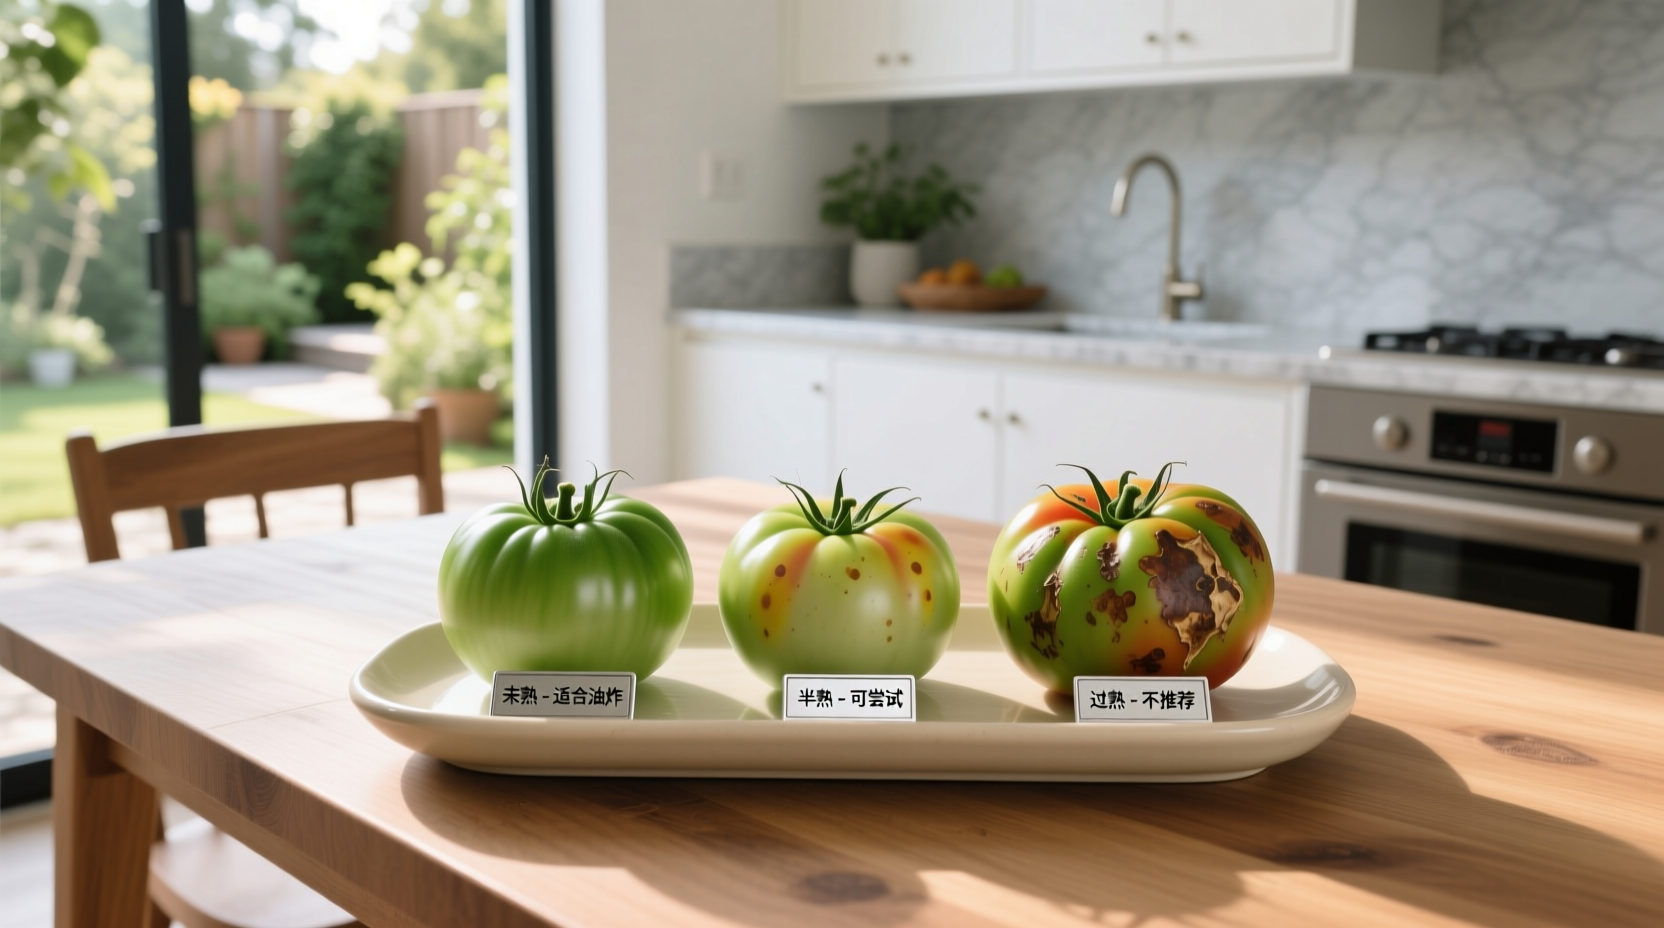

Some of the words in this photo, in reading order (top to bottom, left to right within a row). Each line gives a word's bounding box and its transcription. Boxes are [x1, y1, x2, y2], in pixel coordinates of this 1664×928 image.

[502, 685, 538, 706] 未熟
[552, 686, 624, 708] 适合油炸
[797, 687, 833, 708] 半熟
[850, 687, 904, 709] 可尝试
[1090, 689, 1126, 710] 过熟
[1142, 689, 1195, 710] 不推荐
